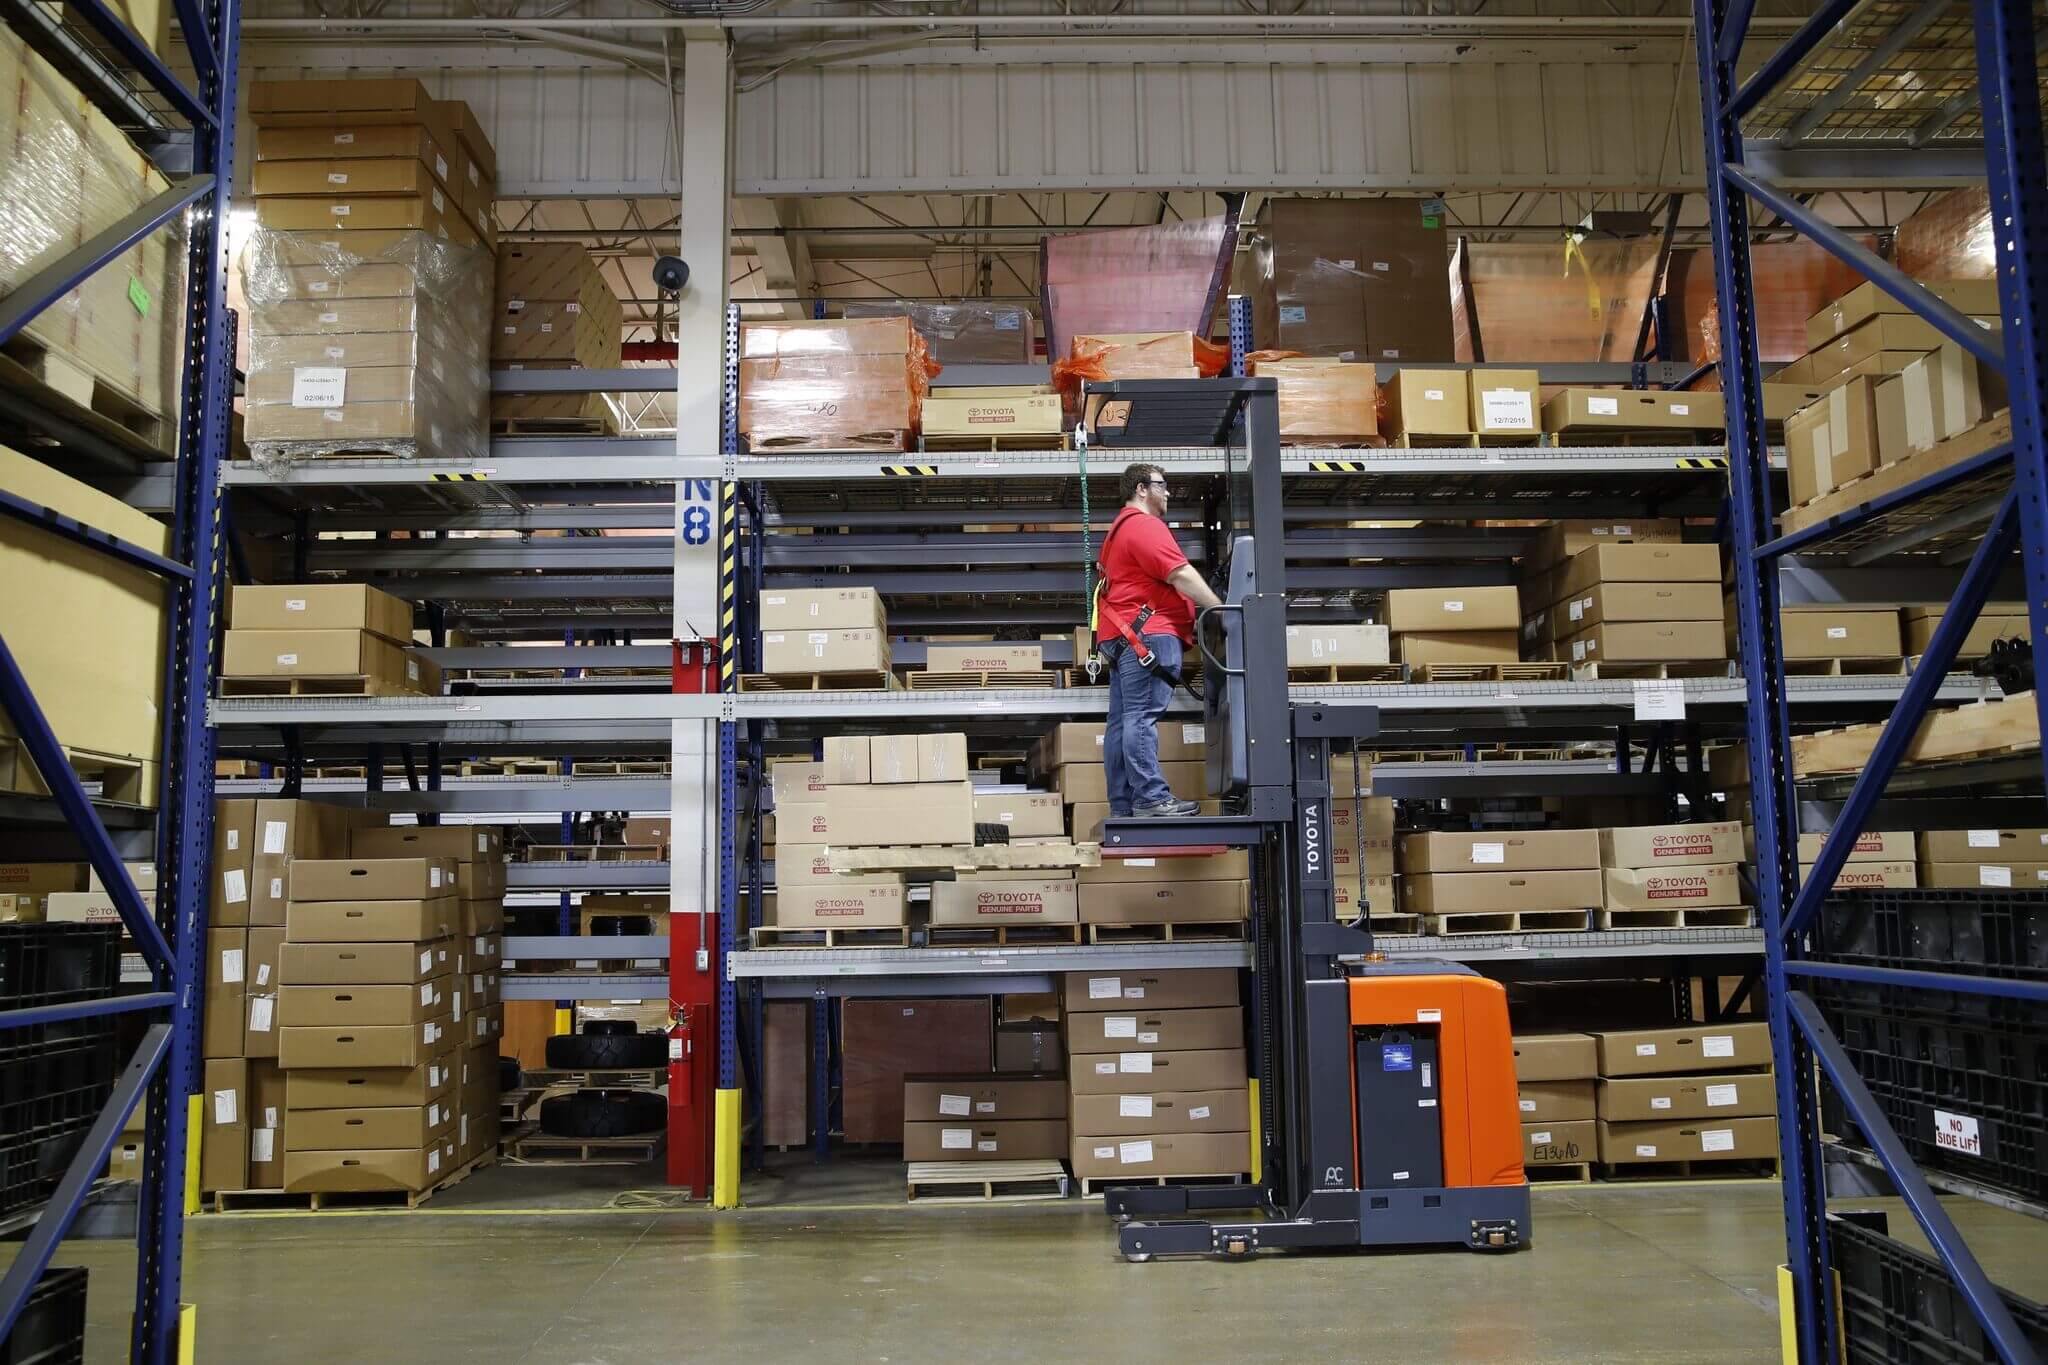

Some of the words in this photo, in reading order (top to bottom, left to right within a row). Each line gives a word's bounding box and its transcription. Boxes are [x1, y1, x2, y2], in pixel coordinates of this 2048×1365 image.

[683, 506, 711, 545] 8
[1305, 804, 1319, 874] TOYOTA
[1670, 834, 1712, 845] TOYOTA
[1656, 847, 1687, 856] GENUINE
[1687, 846, 1711, 854] PARTS
[1664, 877, 1707, 887] TOYOTA
[1840, 873, 1884, 883] TOYOTA
[997, 893, 1042, 902] TOYOTA
[1950, 1119, 1963, 1132] NO
[1937, 1132, 1957, 1147] SIDE
[1959, 1136, 1978, 1151] LIFT
